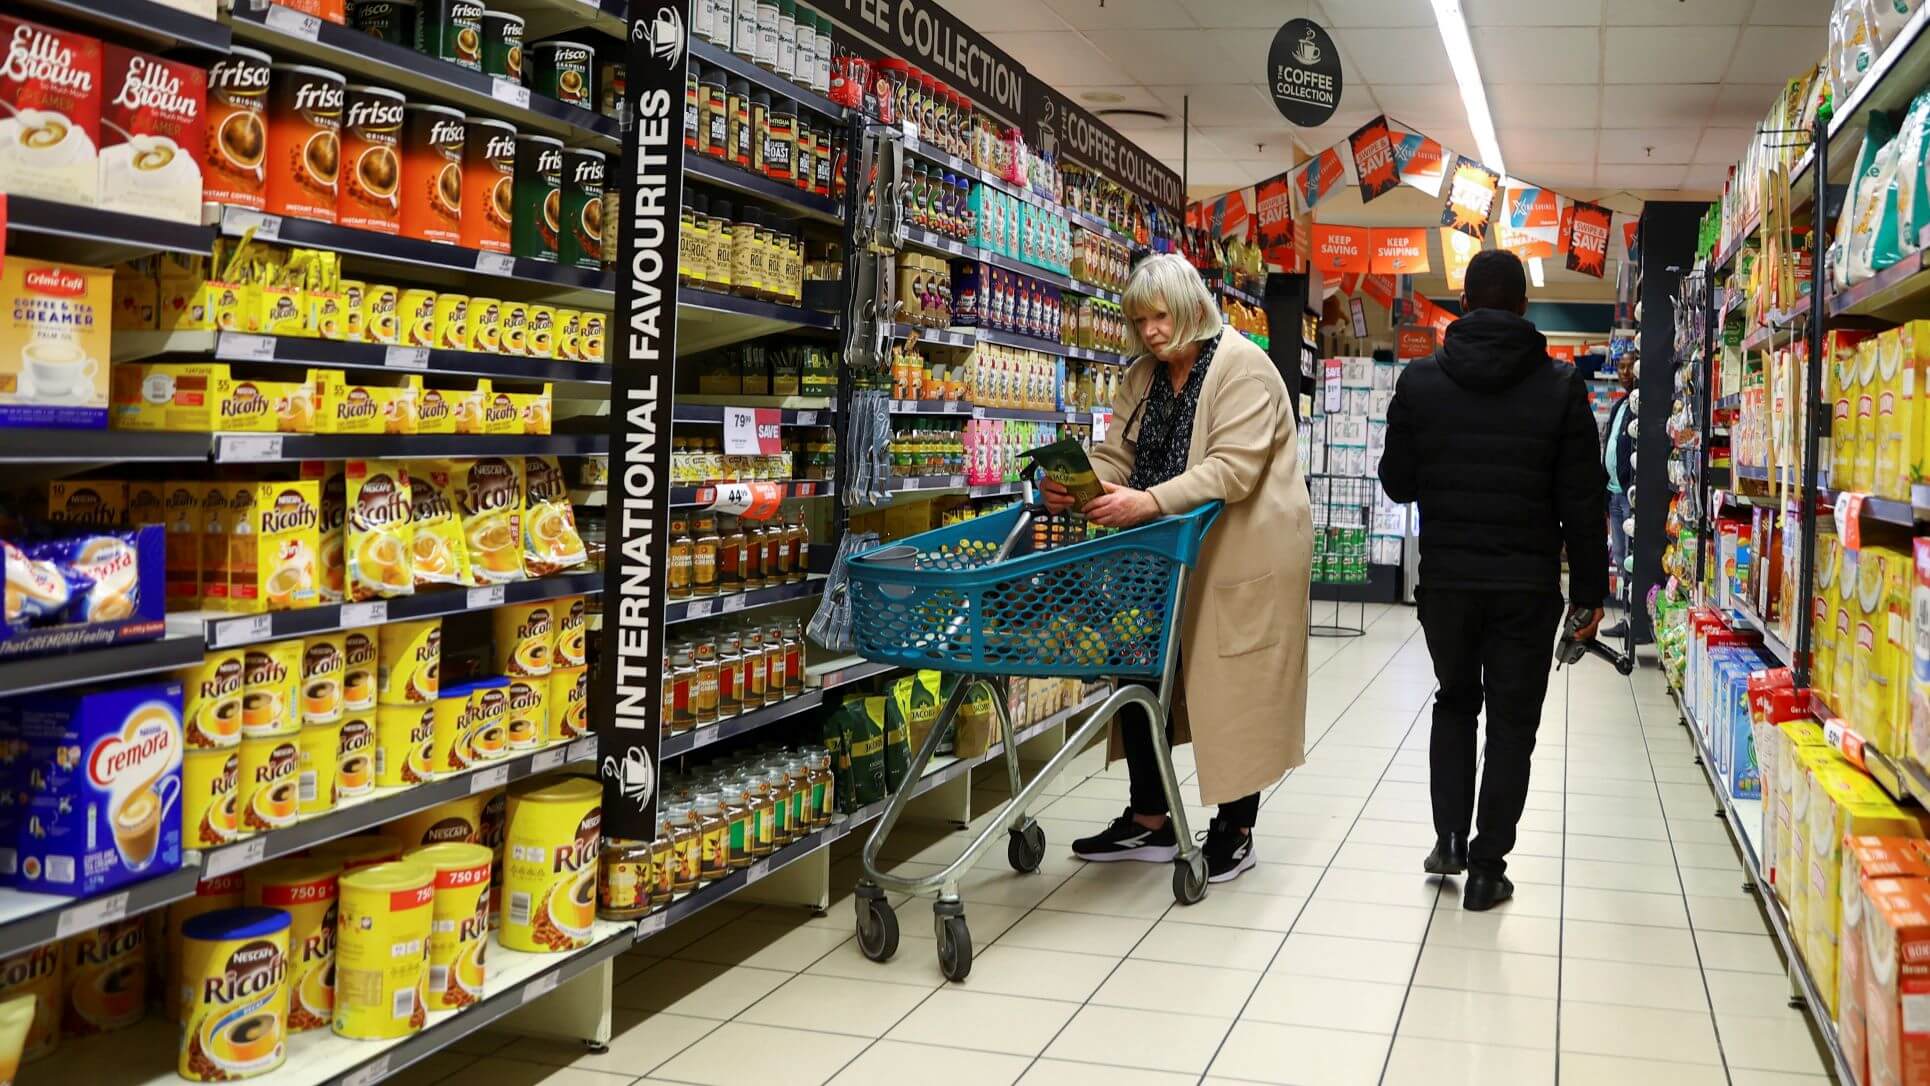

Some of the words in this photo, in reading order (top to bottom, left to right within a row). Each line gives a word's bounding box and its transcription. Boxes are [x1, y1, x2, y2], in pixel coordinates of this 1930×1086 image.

[451, 3, 482, 18] frisco
[10, 24, 73, 68] Ellis
[555, 48, 588, 64] frisco
[898, 0, 1022, 114] COLLECTION
[0, 48, 92, 91] Brown
[126, 56, 180, 94] Ellis
[208, 60, 271, 89] frisco
[1283, 67, 1333, 92] COFFEE
[112, 76, 197, 117] Brown
[1276, 83, 1333, 104] COLLECTION
[348, 101, 404, 127] frisco
[1067, 112, 1116, 173] COFFEE
[1119, 146, 1181, 211] COLLECTION
[1359, 148, 1394, 179] SAVE
[629, 88, 671, 361] FAVOURITES
[1259, 205, 1290, 228] SAVE
[1321, 245, 1358, 256] SAVING
[1327, 235, 1352, 244] KEEP
[1386, 238, 1410, 247] KEEP
[1572, 231, 1607, 255] SAVE
[1377, 246, 1420, 257] SWIPING
[13, 308, 94, 326] CREAMER
[14, 297, 56, 310] COFFEE
[61, 300, 69, 310] &
[73, 302, 94, 314] TEA
[220, 393, 270, 417] Ricoffy
[337, 396, 378, 419] Ricoffy
[485, 401, 518, 422] Ricoffy
[758, 424, 780, 439] SAVE
[261, 486, 273, 498] 10
[261, 502, 319, 534] Ricoffy
[615, 375, 659, 730] INTERNATIONAL
[88, 729, 169, 786] Cremora
[449, 869, 473, 884] 750
[473, 869, 482, 882] g
[290, 887, 315, 900] 750
